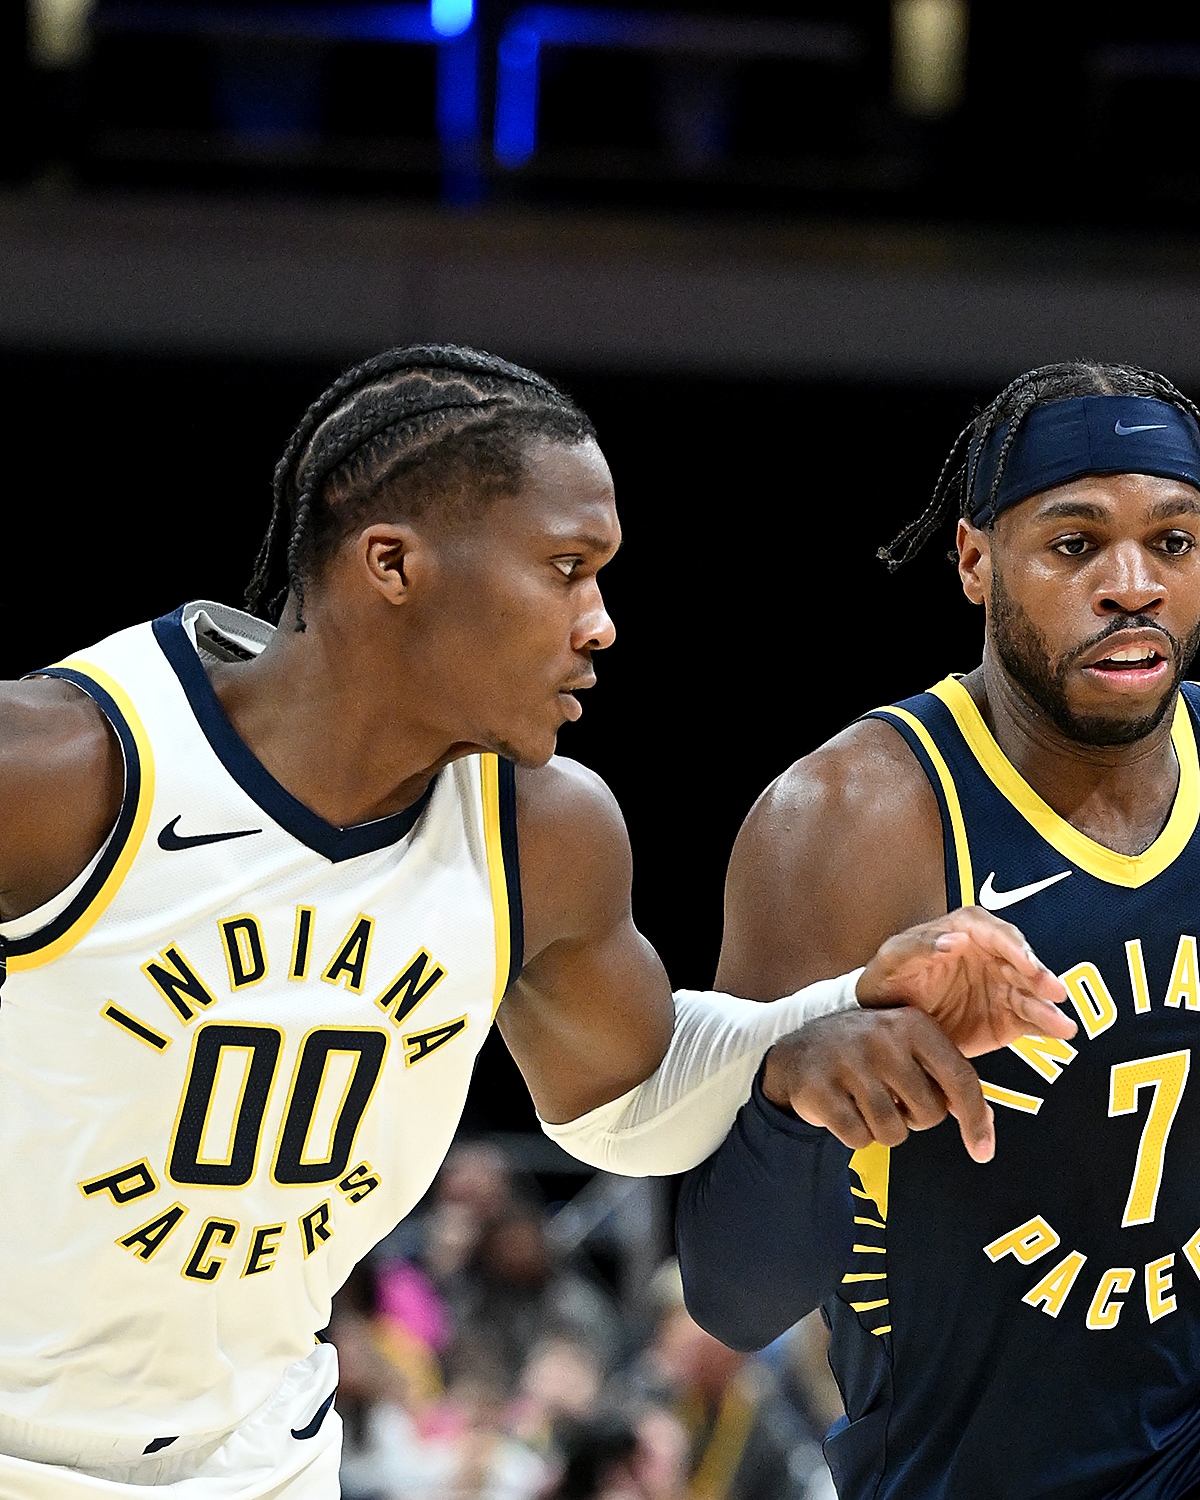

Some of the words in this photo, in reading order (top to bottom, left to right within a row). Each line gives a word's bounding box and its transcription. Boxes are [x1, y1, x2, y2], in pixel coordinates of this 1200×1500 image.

[100, 905, 469, 1068] INDIANA
[165, 1020, 391, 1189] 00
[1108, 1049, 1191, 1228] 7
[77, 1157, 382, 1284] PACERS
